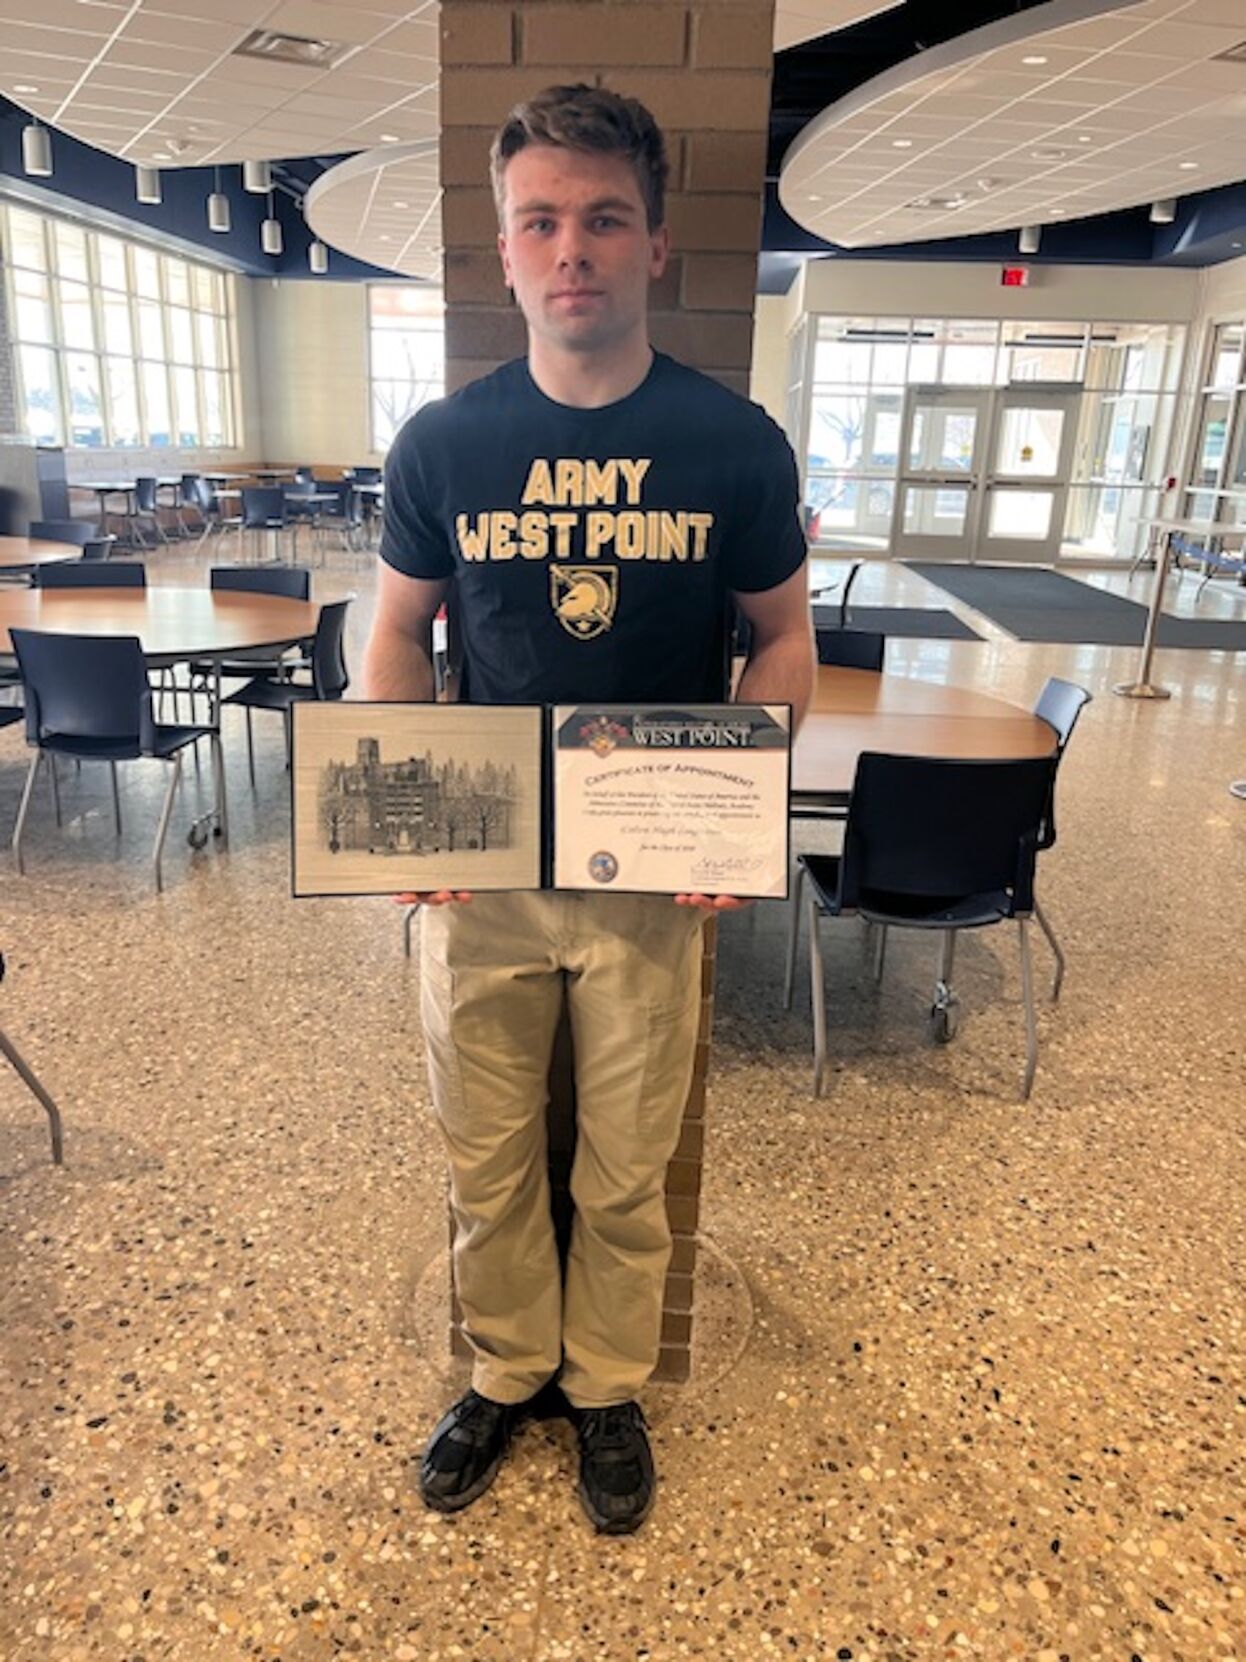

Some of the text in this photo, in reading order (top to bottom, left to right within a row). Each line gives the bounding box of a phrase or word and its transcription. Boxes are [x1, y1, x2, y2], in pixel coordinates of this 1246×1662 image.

[521, 459, 651, 506] ARMY
[456, 511, 713, 562] WEST POINT
[633, 727, 751, 746] WEST POINT
